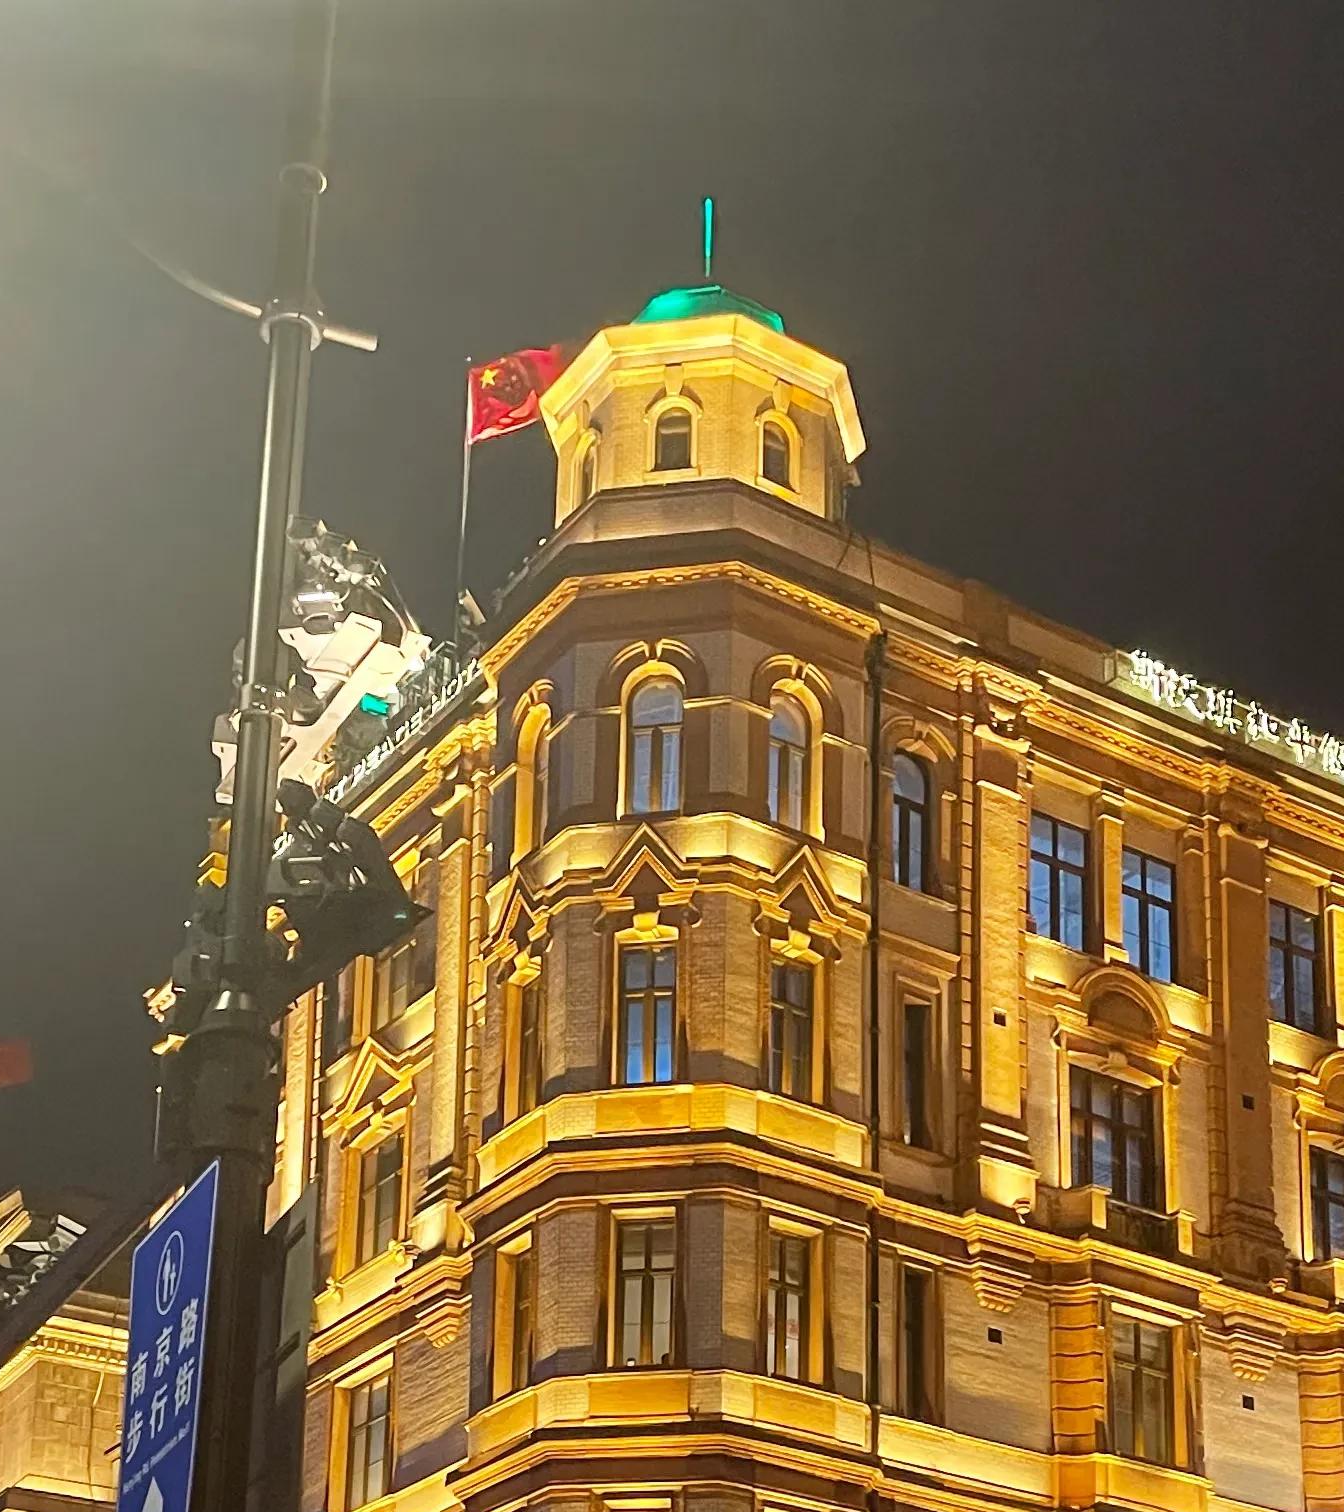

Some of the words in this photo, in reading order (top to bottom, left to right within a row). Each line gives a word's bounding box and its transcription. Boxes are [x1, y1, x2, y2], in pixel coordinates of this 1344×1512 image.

[130, 1298, 199, 1405] 南京路
[125, 1356, 196, 1464] 步行街
